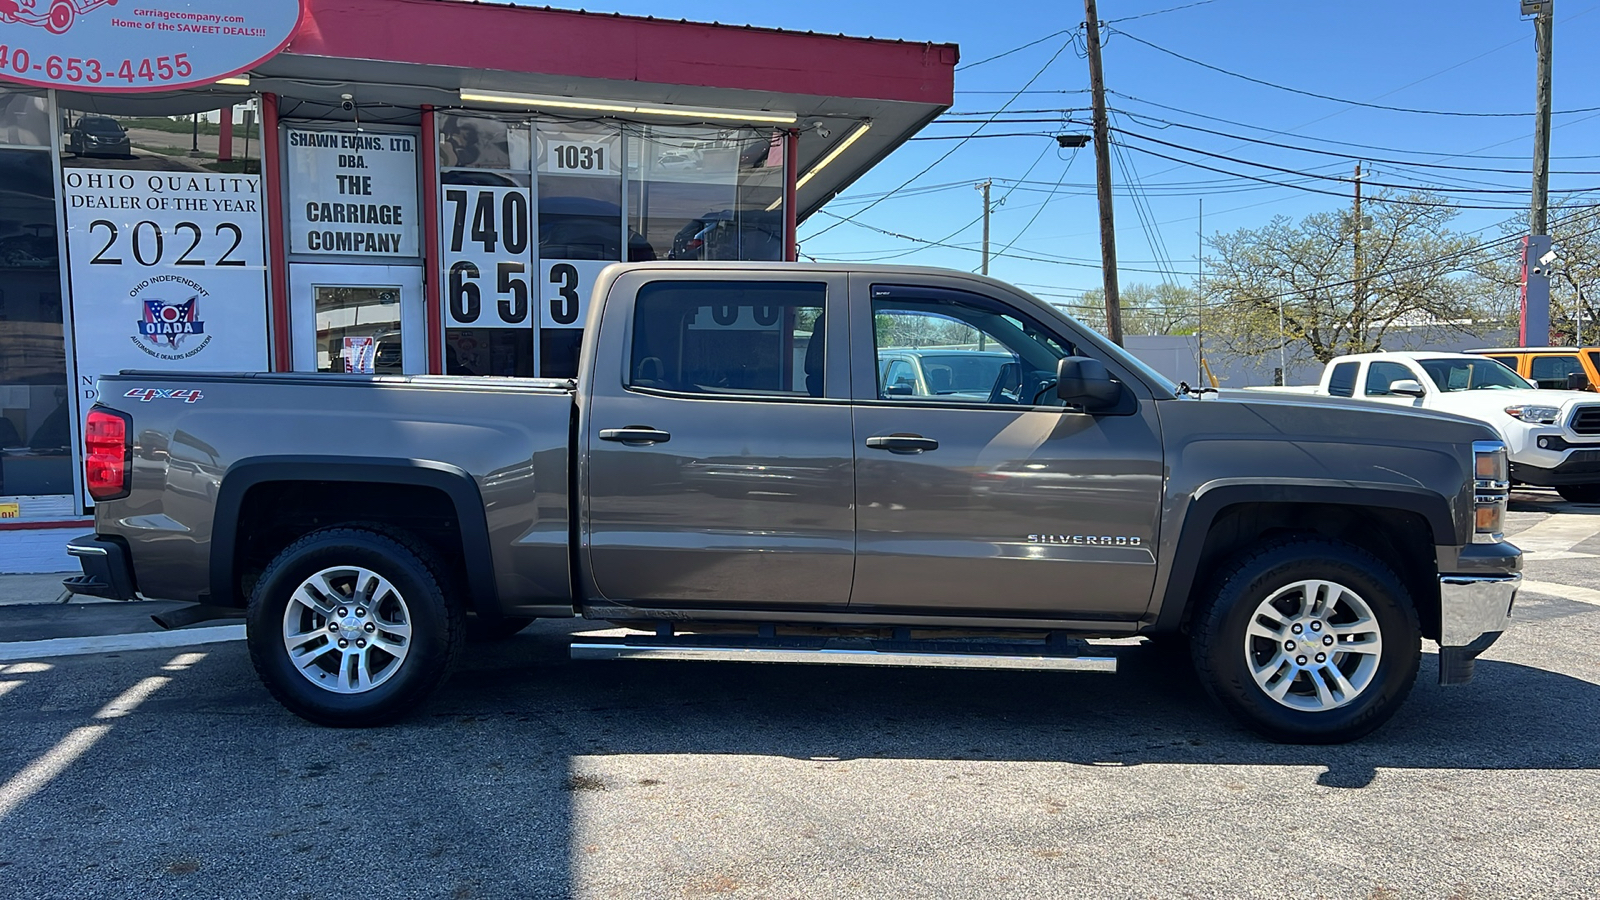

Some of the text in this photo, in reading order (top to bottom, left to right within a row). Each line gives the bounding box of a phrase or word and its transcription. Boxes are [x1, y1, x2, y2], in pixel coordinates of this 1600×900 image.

[133, 8, 244, 24] carriagecompany.com
[111, 18, 266, 37] Home of the SAWEET DEALS!!!
[290, 132, 414, 152] SHAWN EVANS. LTD.
[338, 154, 368, 169] DBA.
[554, 145, 604, 170] 1031
[66, 172, 259, 193] OHIO QUALITY
[336, 174, 372, 196] THE
[70, 194, 257, 213] DEALER OF THE YEAR
[306, 201, 403, 225] CARRIAGE
[446, 189, 528, 255] 740
[89, 219, 246, 267] 2022
[307, 230, 402, 253] COMPANY
[129, 275, 210, 298] OHIO INDEPENDENT
[146, 322, 194, 334] OIADA
[130, 335, 159, 359] AUTOMOBILE
[185, 334, 213, 359] ASSOCIATION
[1027, 534, 1141, 546] SILVERADO
